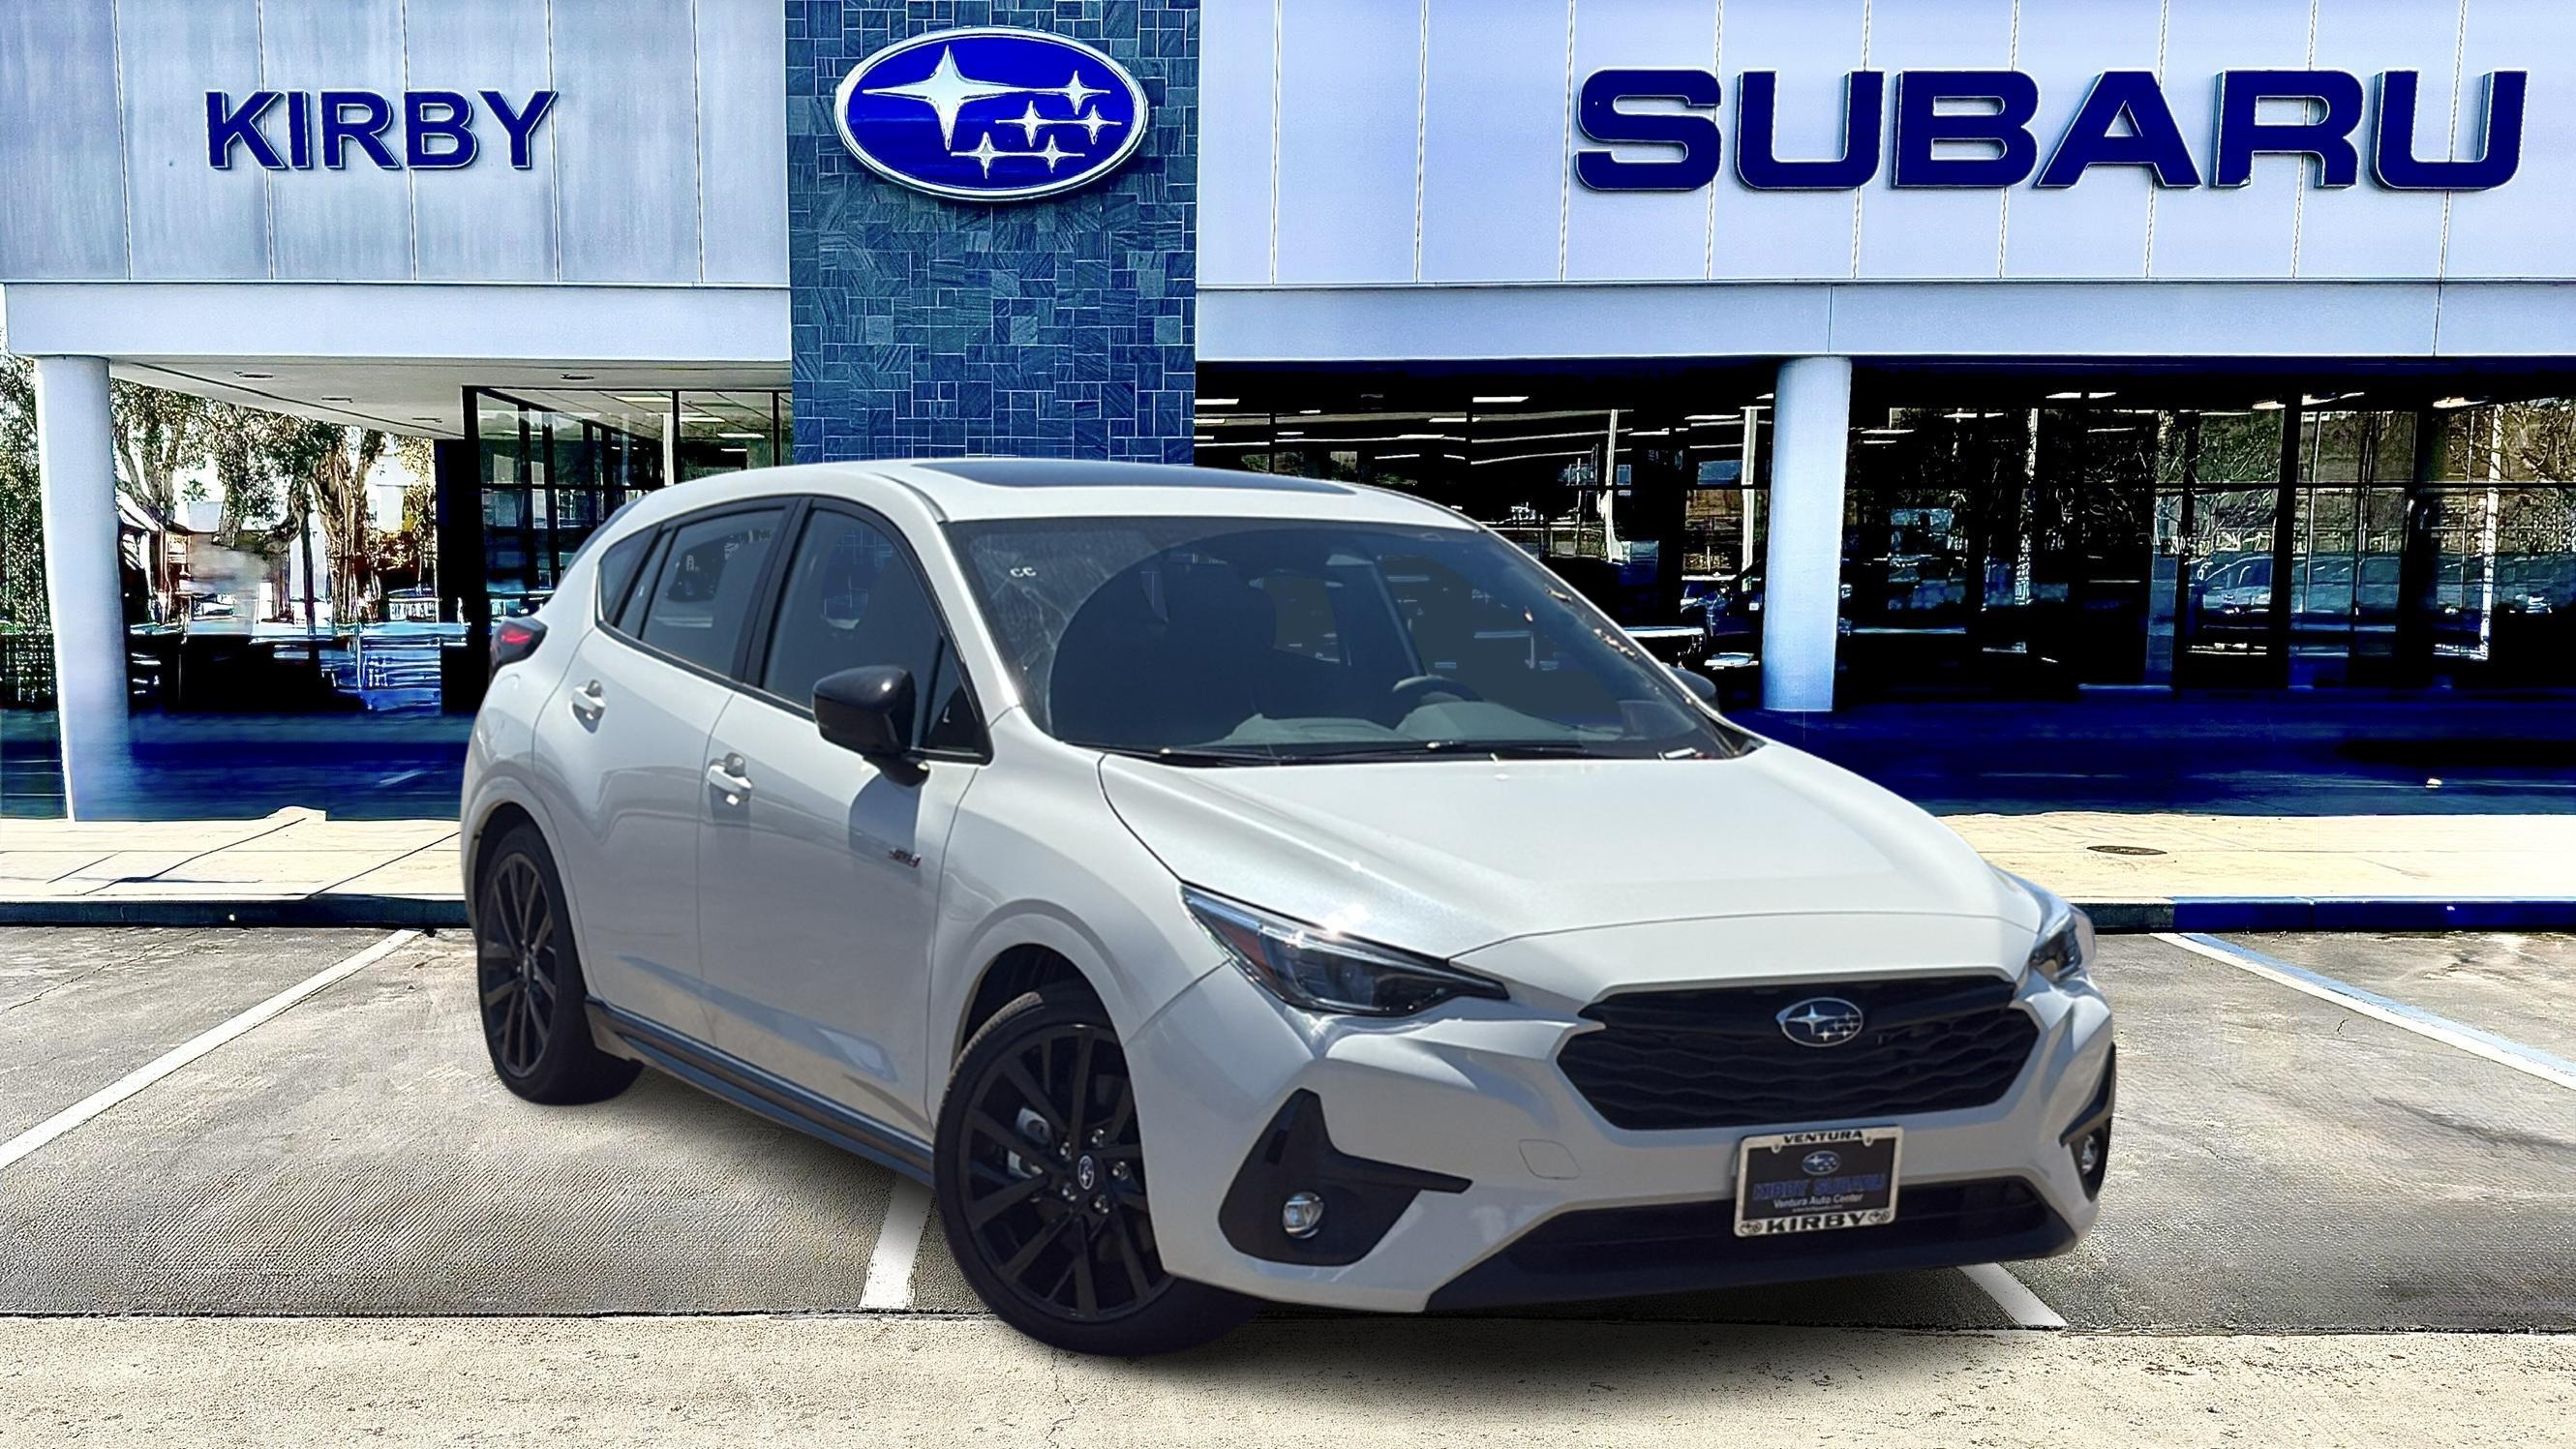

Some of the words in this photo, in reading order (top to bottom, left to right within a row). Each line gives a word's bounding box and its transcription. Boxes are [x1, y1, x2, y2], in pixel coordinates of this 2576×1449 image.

[205, 90, 560, 170] KIRBY
[1574, 68, 2529, 192] SUBARU
[1783, 1130, 1864, 1144] VENTURA
[1773, 1197, 1807, 1209] Ventura
[1809, 1194, 1832, 1205] Auto
[1833, 1192, 1864, 1203] Center
[1766, 1211, 1866, 1234] KIRBY
